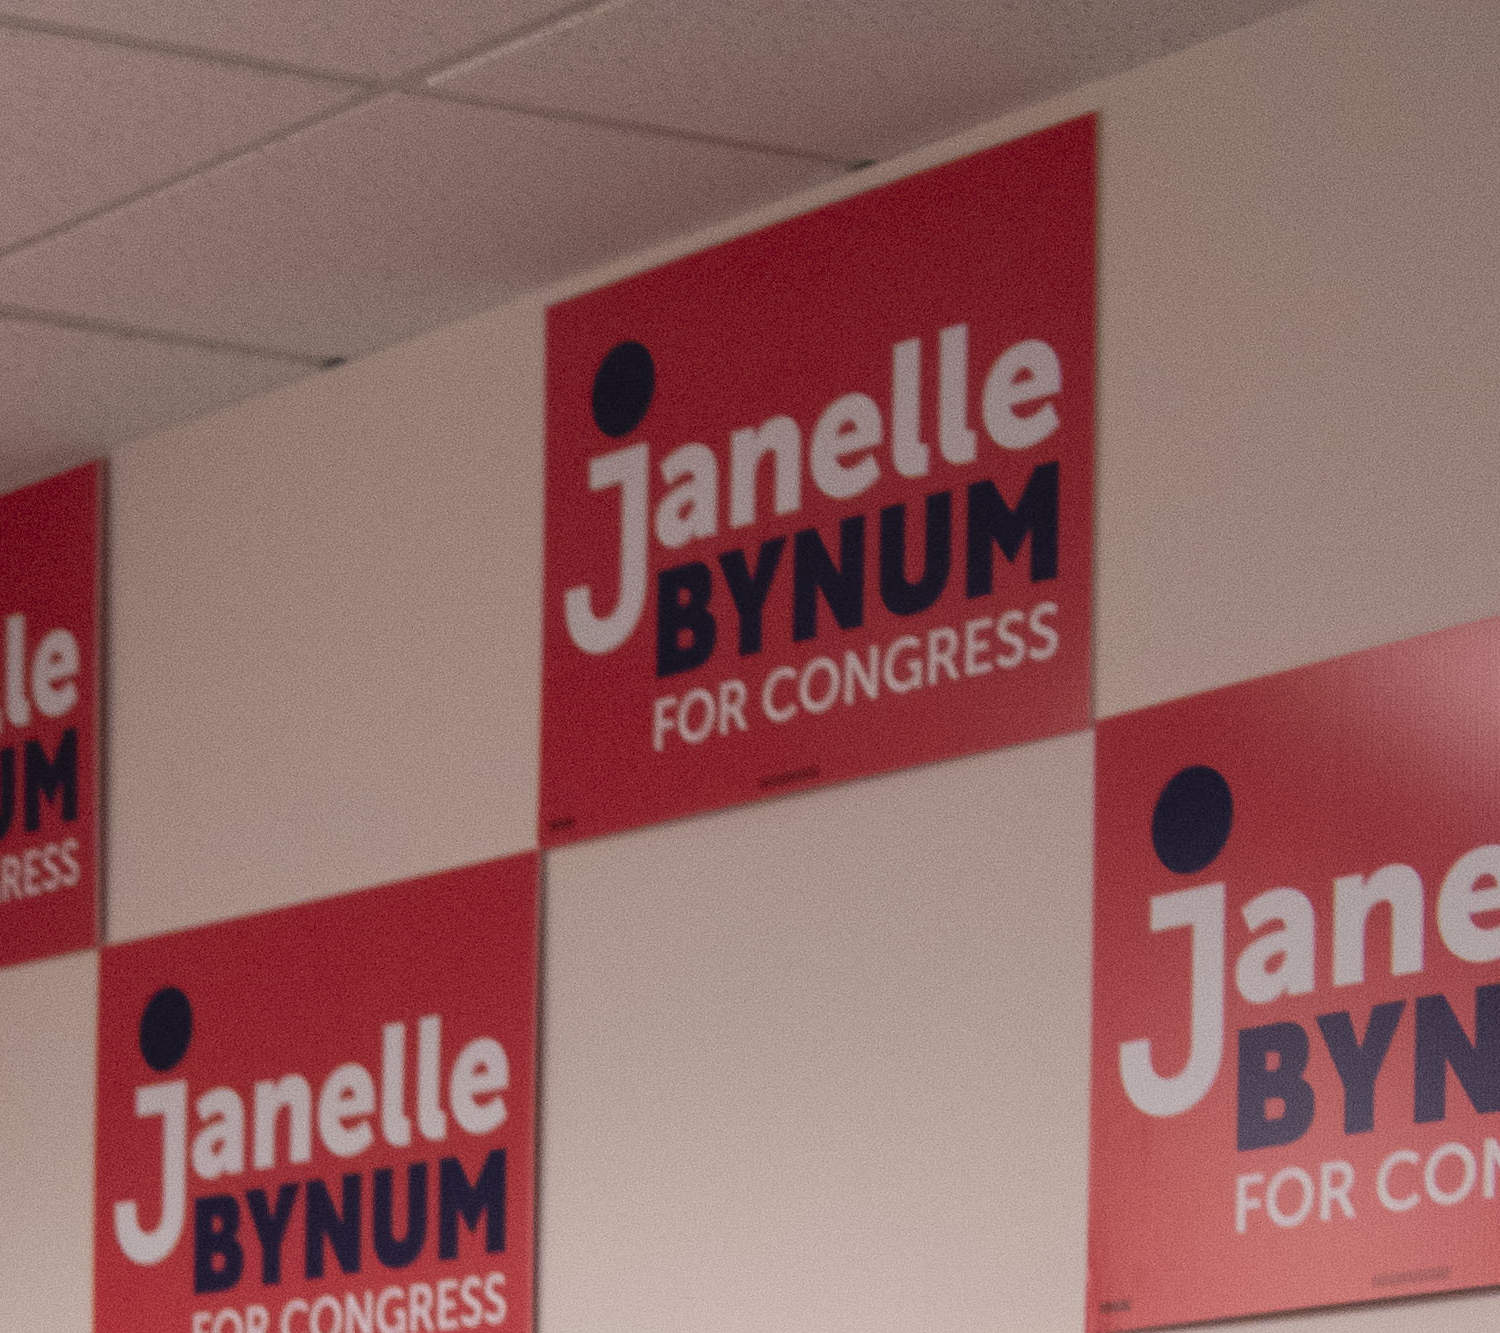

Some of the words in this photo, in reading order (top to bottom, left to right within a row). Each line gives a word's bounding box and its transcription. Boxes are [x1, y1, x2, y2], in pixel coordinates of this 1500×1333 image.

[657, 461, 1059, 679] BYNUM
[654, 679, 747, 750] FOR
[762, 602, 1059, 722] CONGRESS
[1237, 984, 1500, 1152] BYN
[194, 1149, 505, 1294] BYNUM
[1236, 1160, 1355, 1233] FOR
